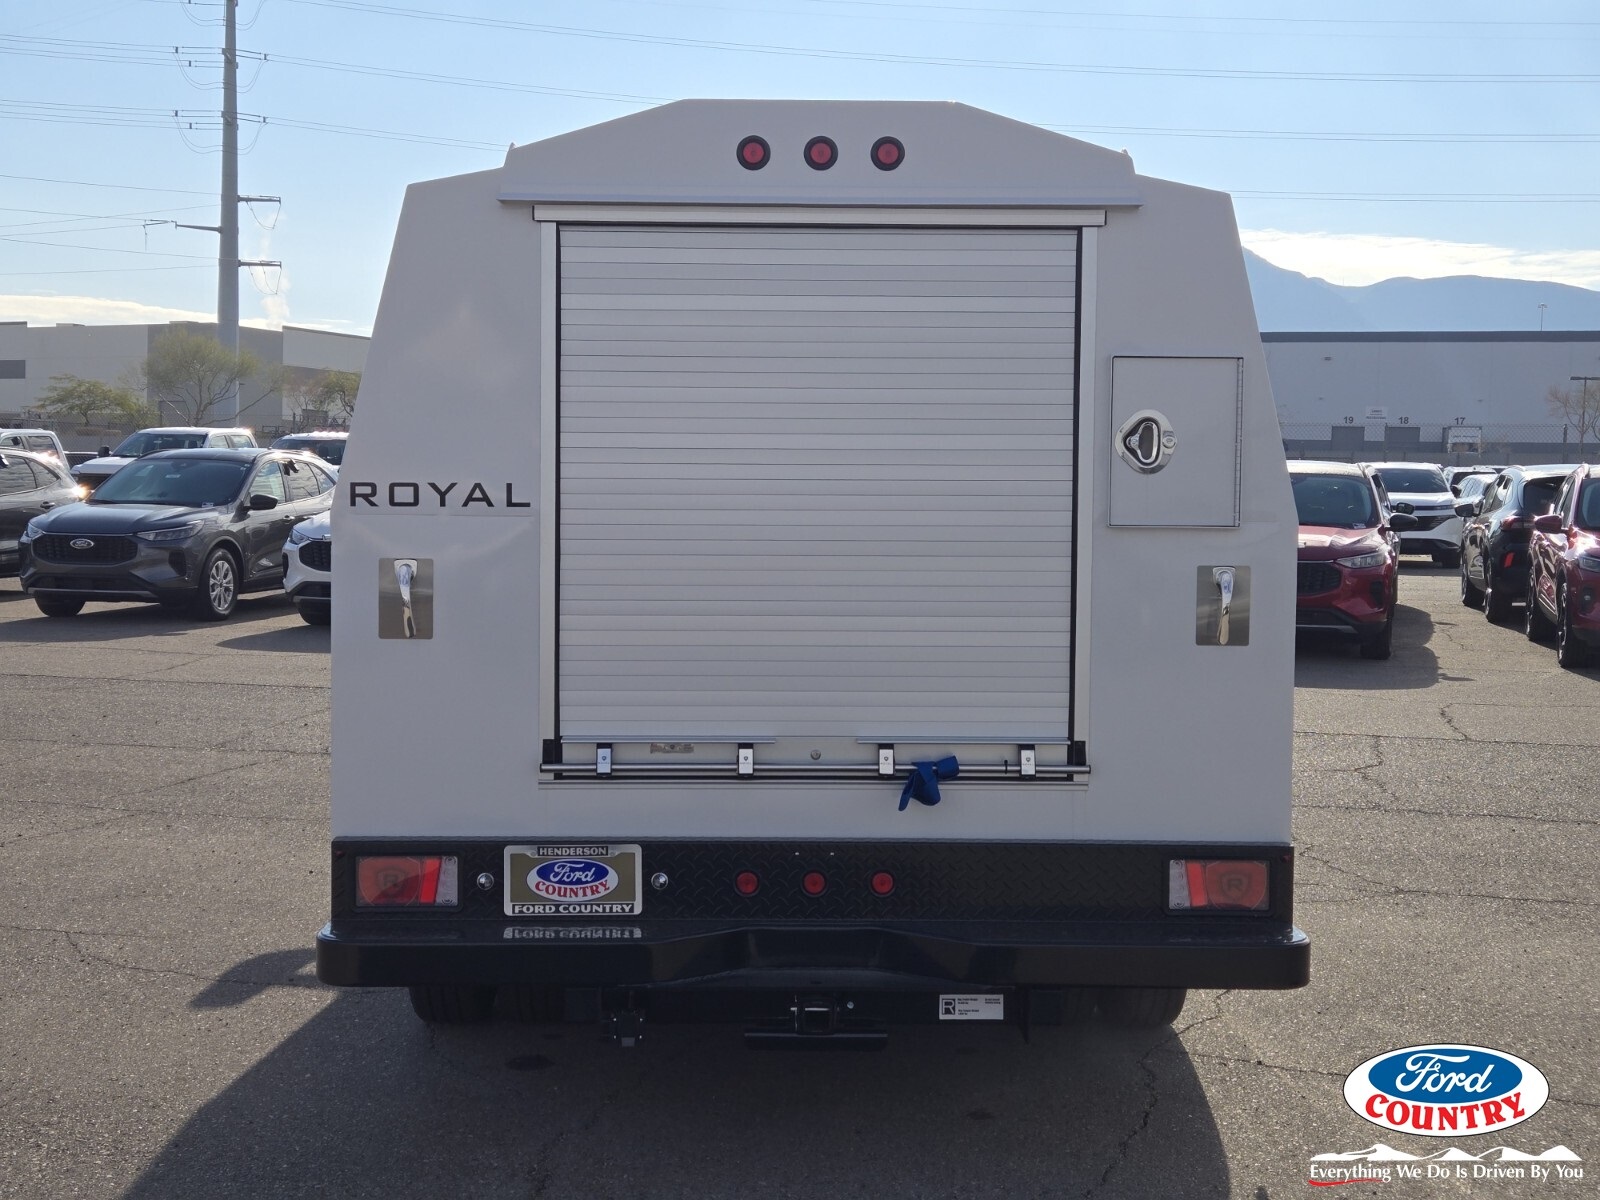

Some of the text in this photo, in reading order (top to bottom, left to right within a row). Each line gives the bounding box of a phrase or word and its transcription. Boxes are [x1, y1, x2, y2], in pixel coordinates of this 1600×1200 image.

[1343, 416, 1354, 424] 19
[1398, 416, 1409, 425] 18
[1454, 417, 1466, 425] 17
[350, 482, 531, 507] ROYAL
[539, 847, 607, 856] HENDERSON
[550, 862, 595, 882] Ford
[534, 880, 610, 898] COUNTRY
[514, 904, 633, 914] FORD COUNTRY
[942, 999, 955, 1014] R
